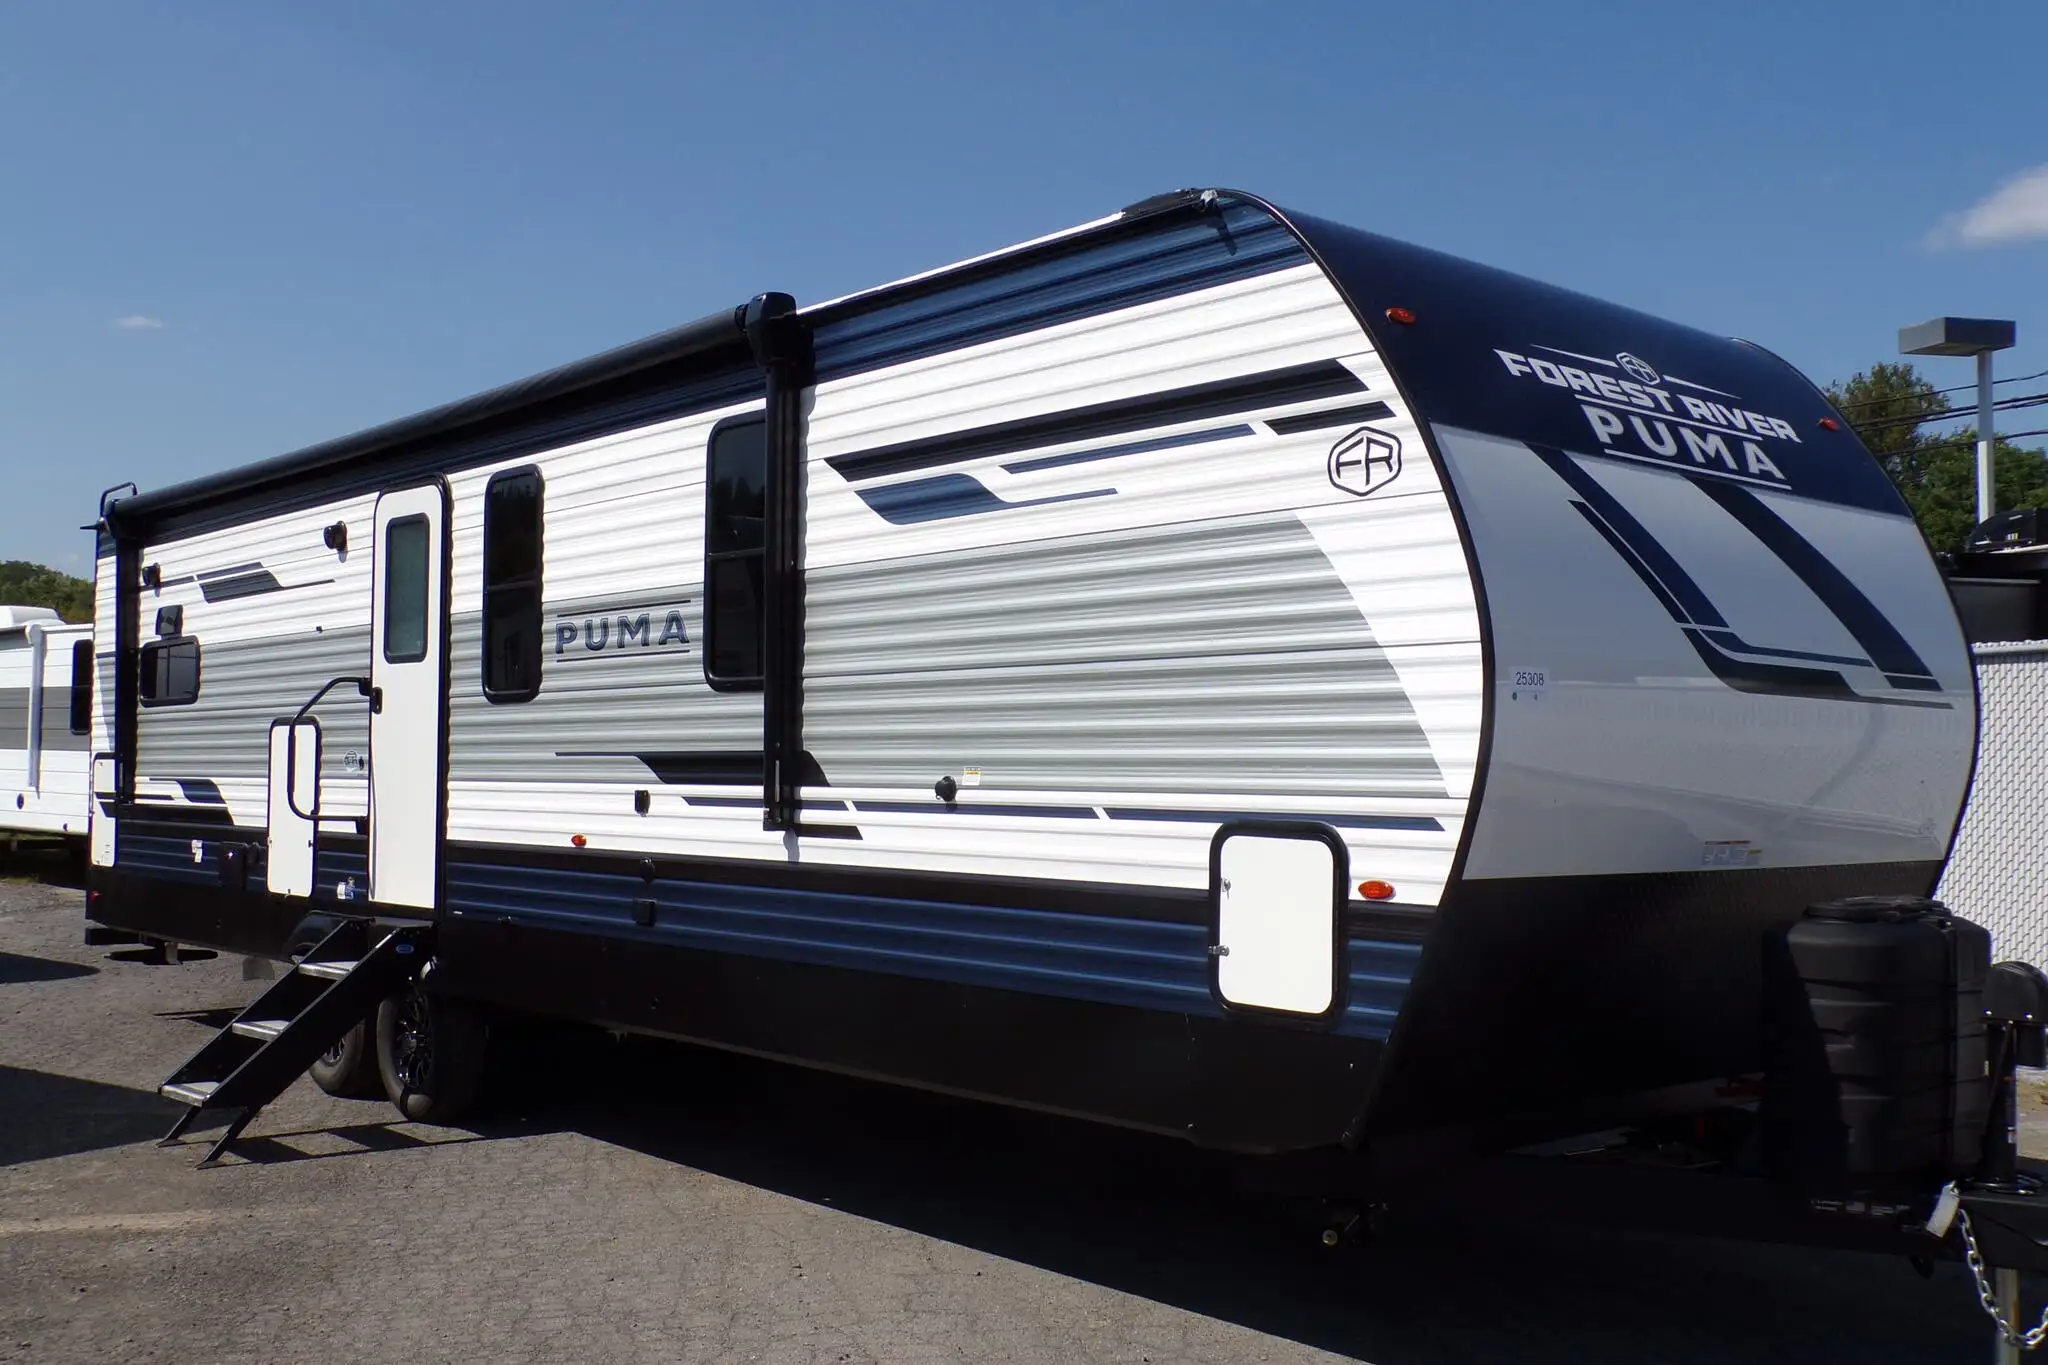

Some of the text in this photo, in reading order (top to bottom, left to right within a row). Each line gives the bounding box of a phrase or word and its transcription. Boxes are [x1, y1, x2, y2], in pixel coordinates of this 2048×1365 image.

[1493, 349, 1802, 443] FOREST RIVER
[1581, 404, 1788, 480] PUMA
[555, 610, 690, 654] PUMA
[1515, 671, 1545, 686] 25308
